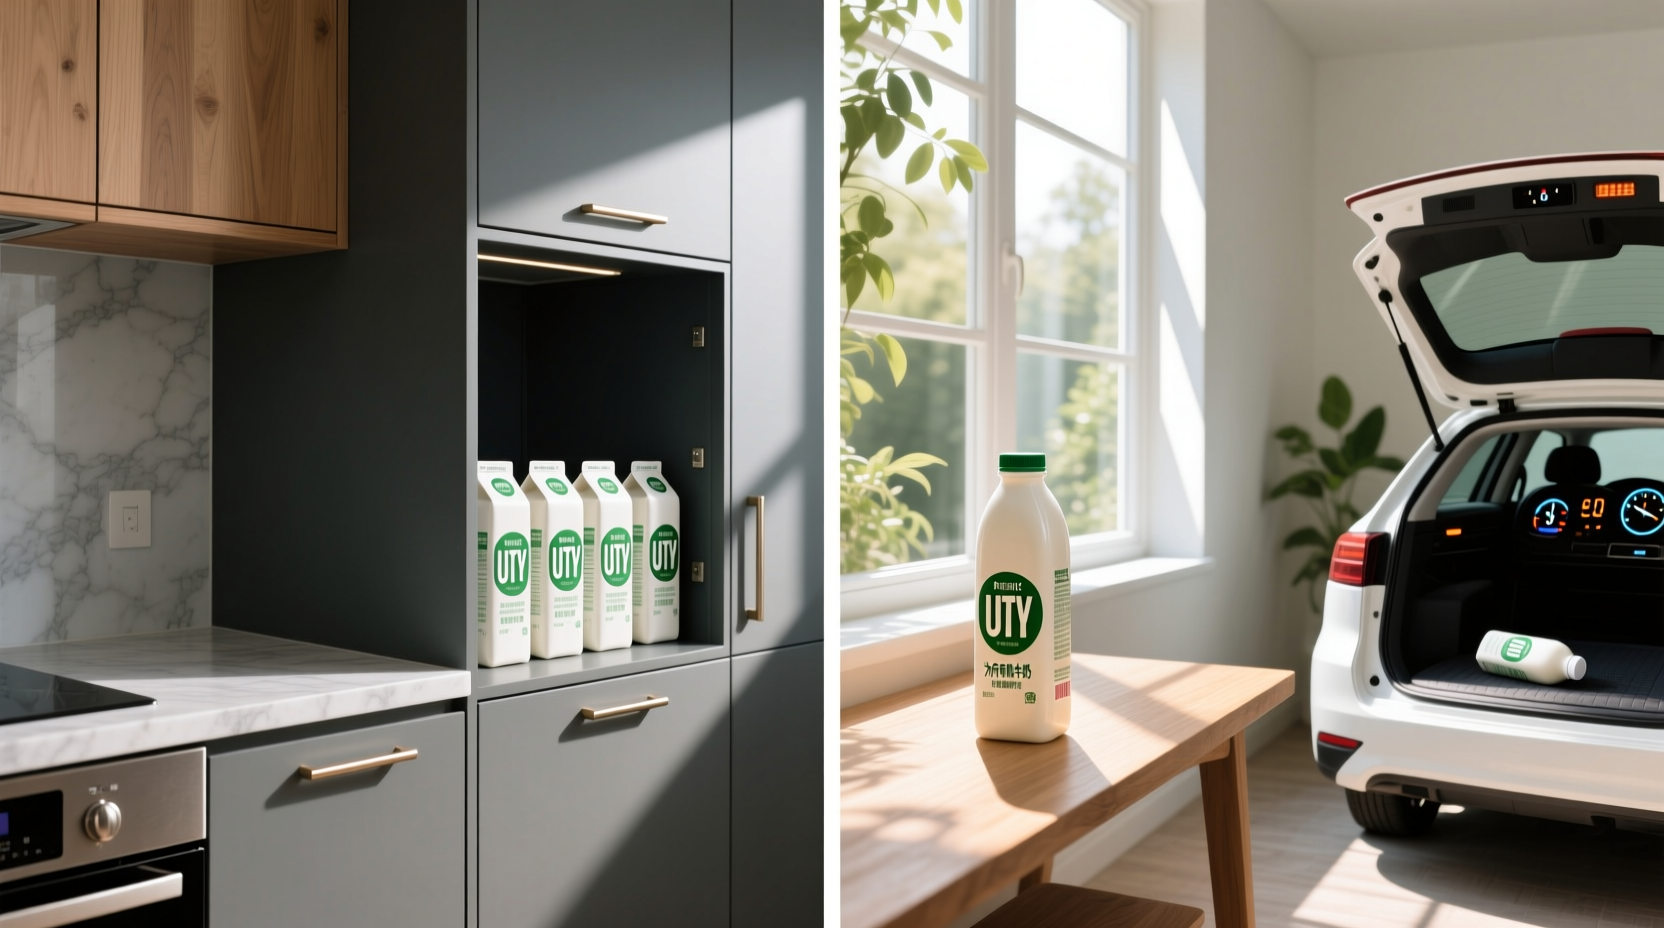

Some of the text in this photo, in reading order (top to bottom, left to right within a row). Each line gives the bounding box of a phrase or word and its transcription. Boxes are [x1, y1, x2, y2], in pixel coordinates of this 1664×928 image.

[498, 549, 527, 584] UTY
[552, 545, 581, 579] UTY
[604, 543, 630, 576] UTY
[652, 540, 677, 571] UTY
[985, 594, 1033, 638] UTY
